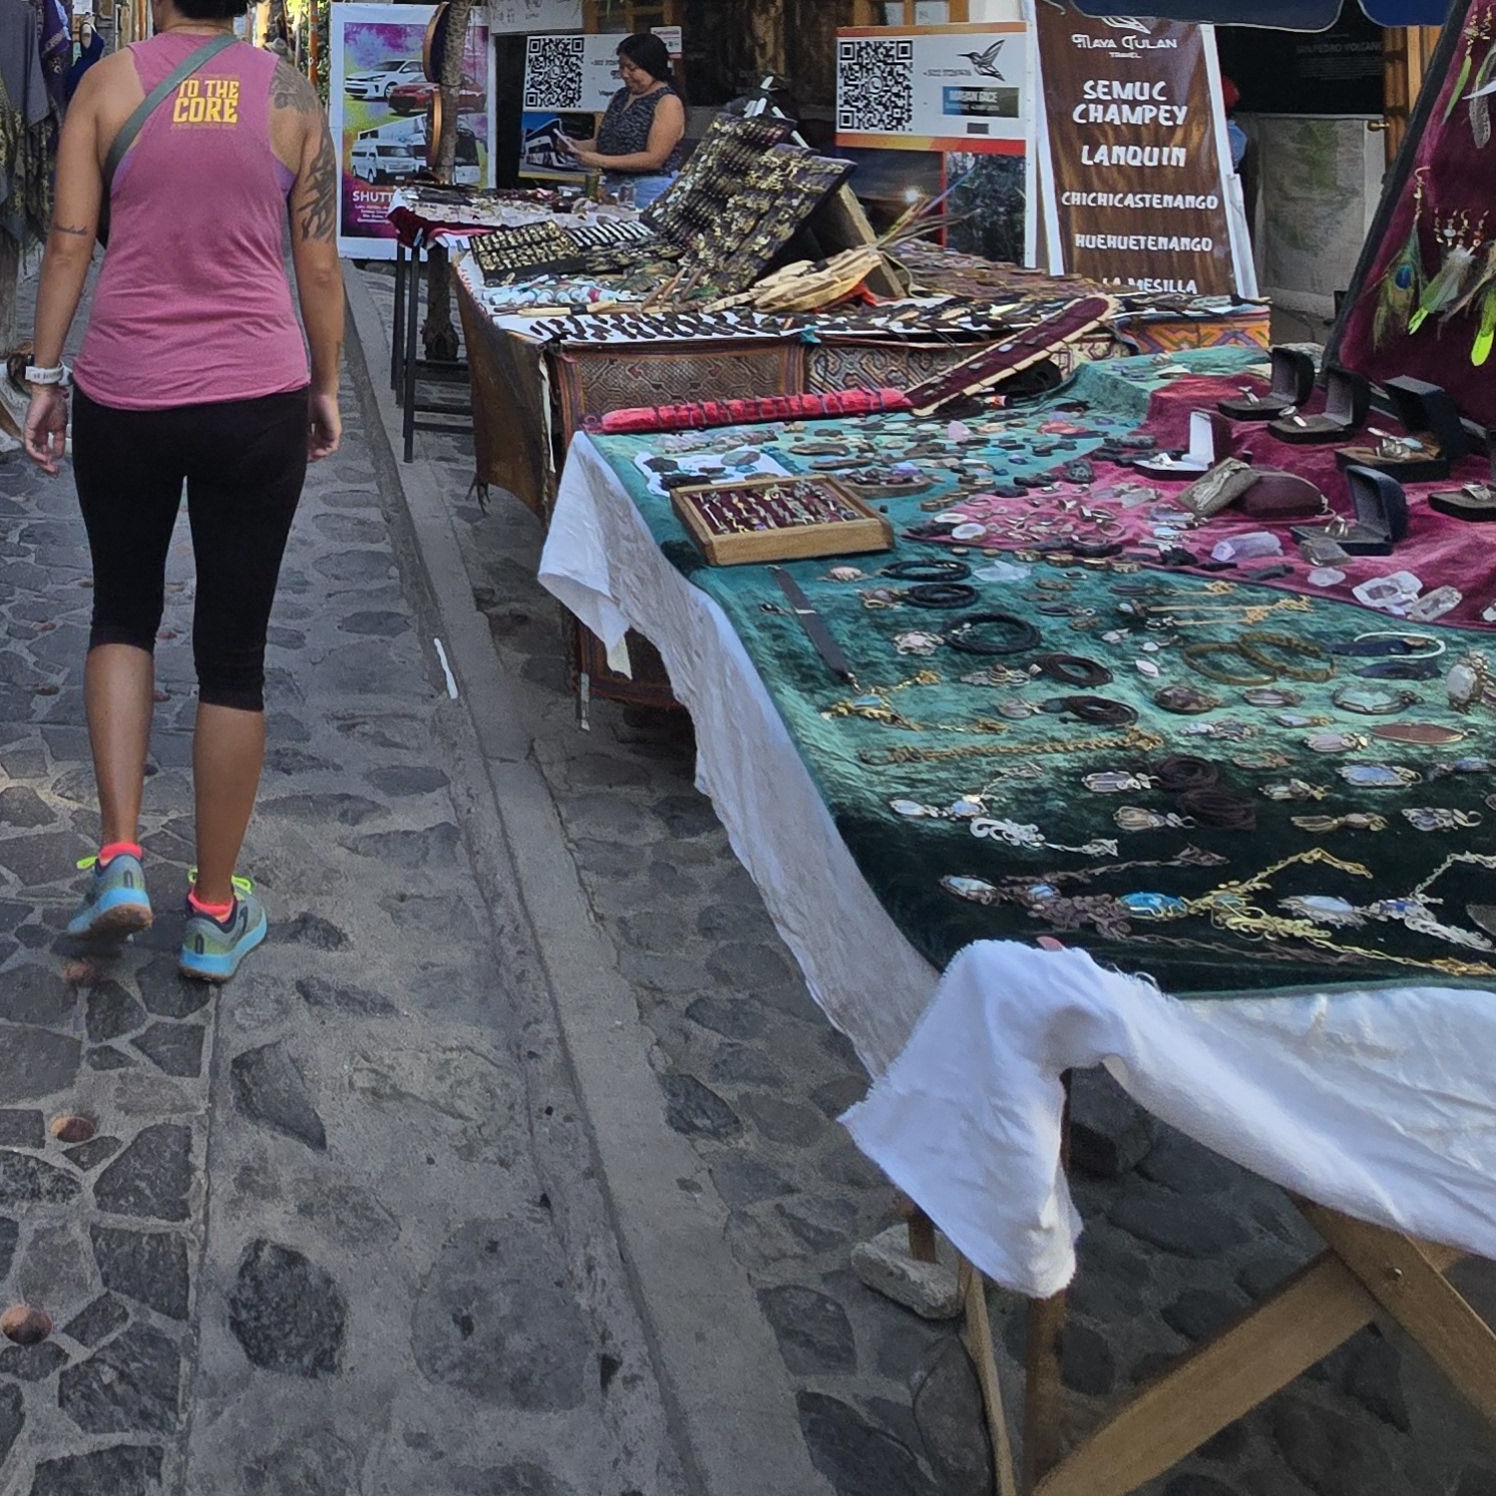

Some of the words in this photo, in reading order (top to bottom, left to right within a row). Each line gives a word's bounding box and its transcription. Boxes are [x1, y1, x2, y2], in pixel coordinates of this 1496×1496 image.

[178, 80, 199, 98] TO
[204, 80, 240, 99] THE
[1083, 80, 1168, 101] SEMUC
[173, 97, 238, 123] CORE
[1072, 103, 1188, 126] CHAMPEY
[1081, 144, 1186, 167] LANQUIN
[352, 190, 393, 202] SHUTT
[1061, 192, 1219, 209] CHICHICASTENANGO
[1075, 233, 1213, 251] HUEHUETENANGO
